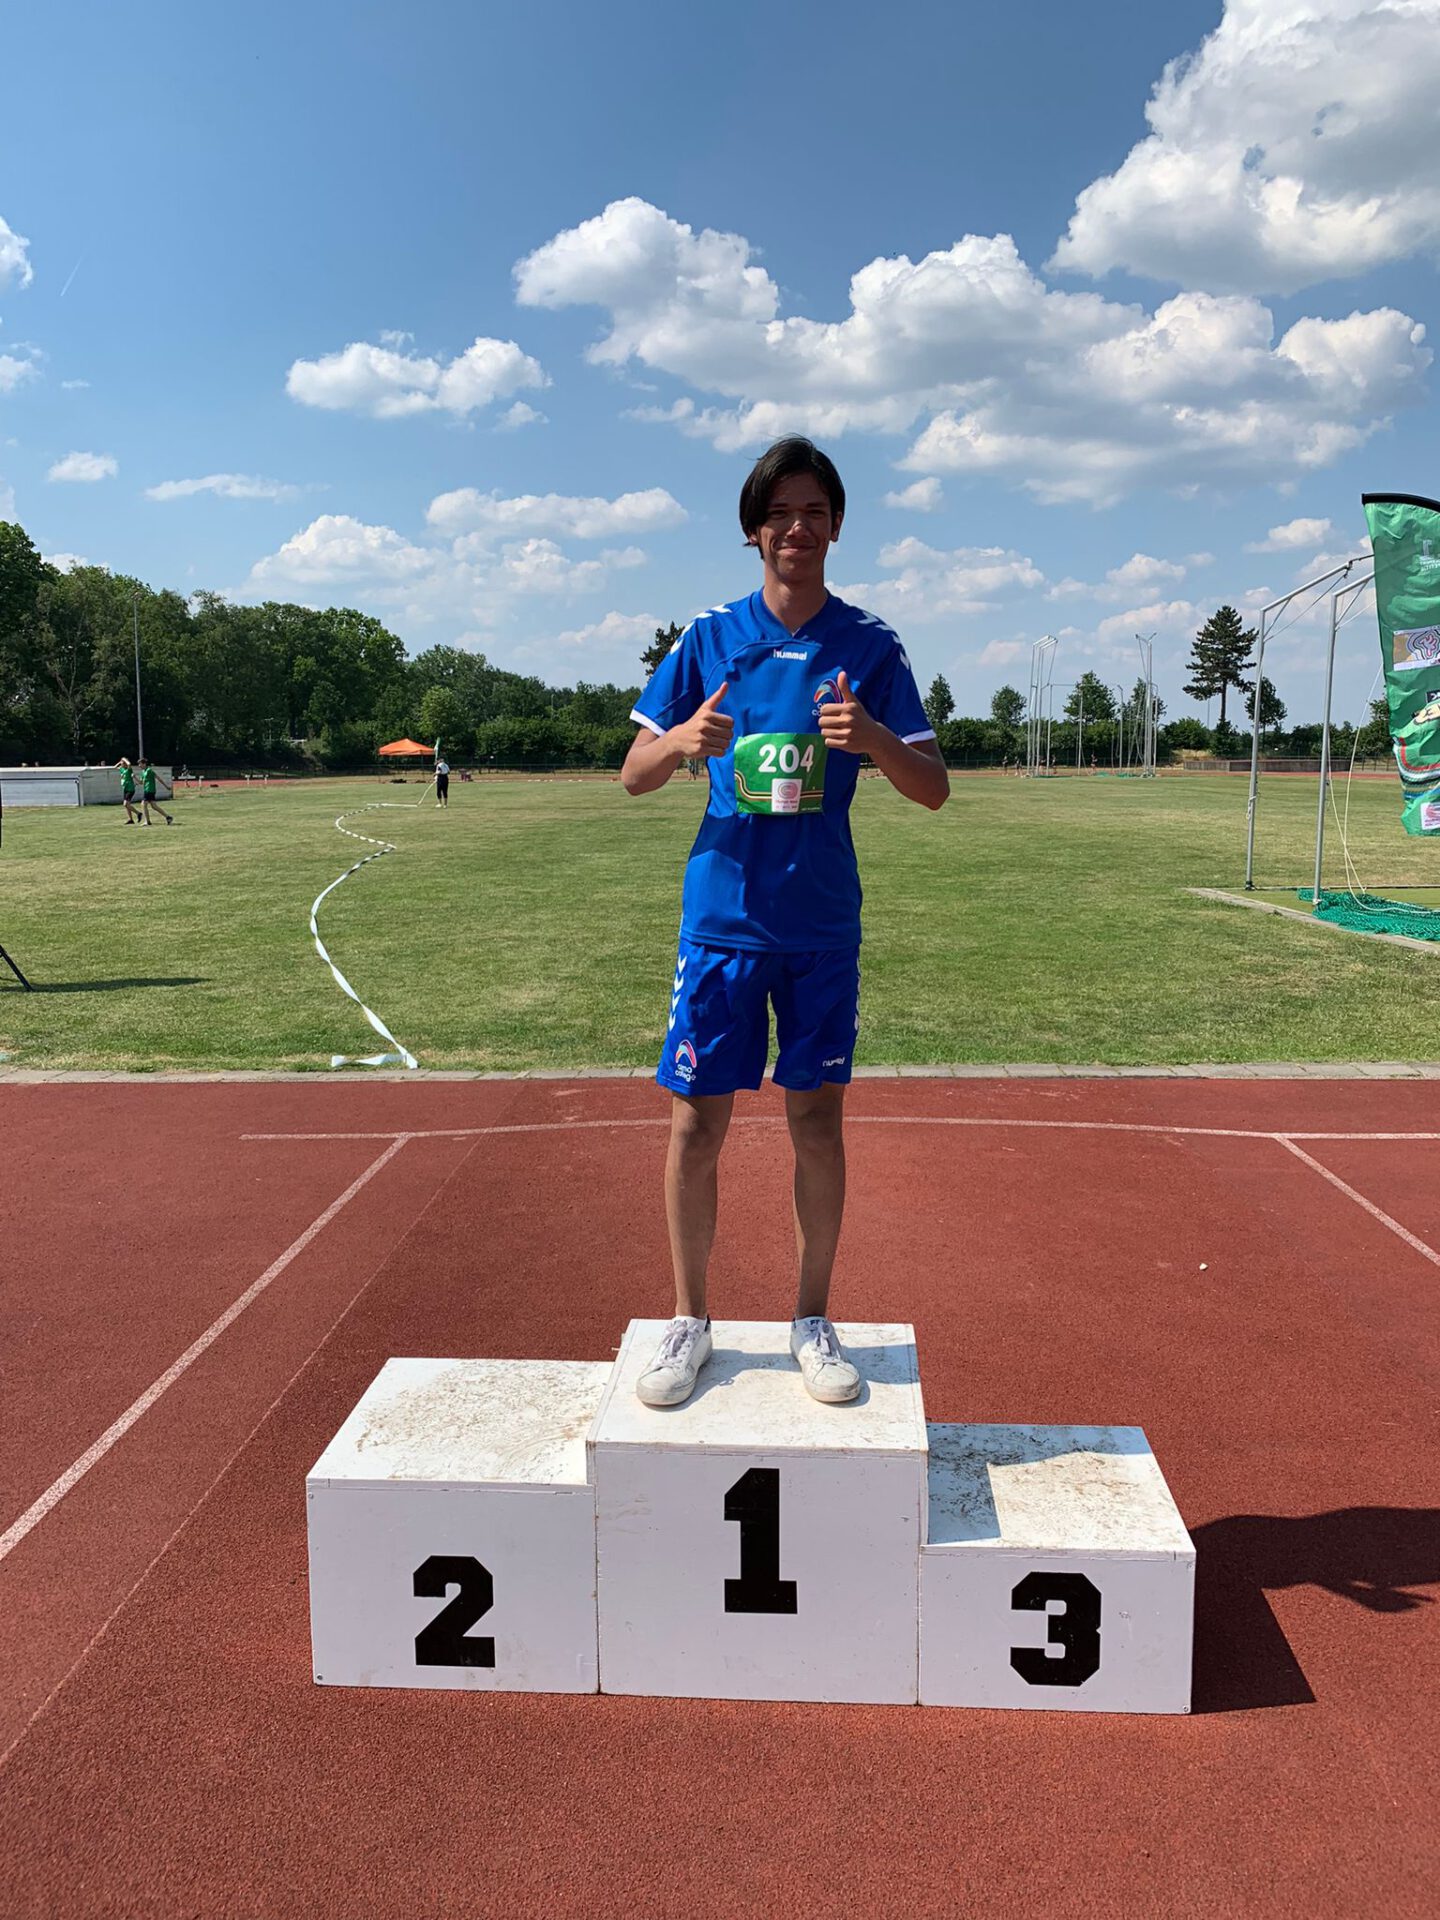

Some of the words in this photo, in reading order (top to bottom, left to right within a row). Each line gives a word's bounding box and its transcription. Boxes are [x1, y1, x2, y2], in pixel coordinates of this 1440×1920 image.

[758, 744, 814, 773] 204
[724, 1468, 797, 1614] 1
[413, 1556, 495, 1667] 2
[1010, 1572, 1101, 1686] 3
